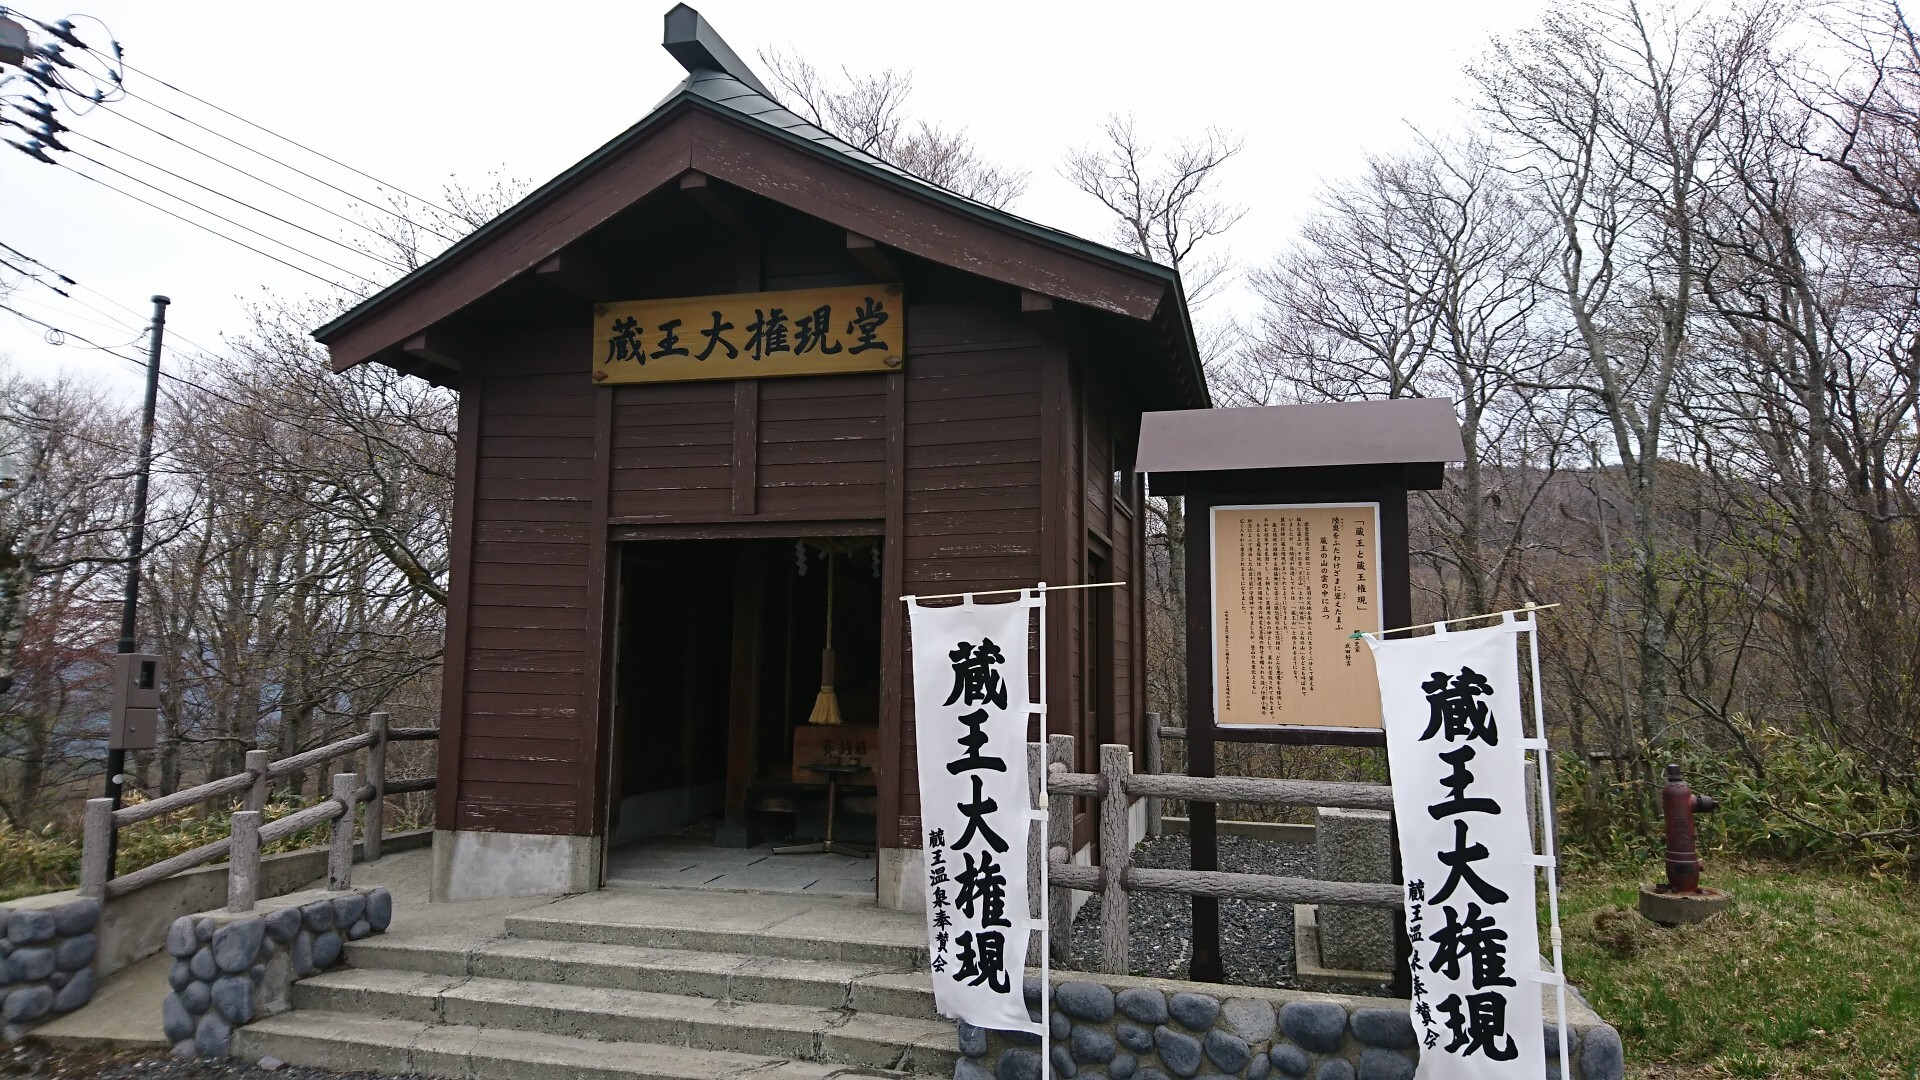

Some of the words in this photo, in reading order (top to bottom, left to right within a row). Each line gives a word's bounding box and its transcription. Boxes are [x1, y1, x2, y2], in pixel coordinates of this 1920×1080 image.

[604, 296, 889, 366] 蔵王大権現堂
[1320, 537, 1330, 620] 蔵王の山の雲の中に立つ
[1354, 519, 1367, 611] 「蔵王と蔵王権現」
[942, 637, 1011, 994] 蔵王大権現
[1417, 666, 1519, 1062] 蔵王大権現
[928, 829, 953, 973] 蔵王温泉奉賛会
